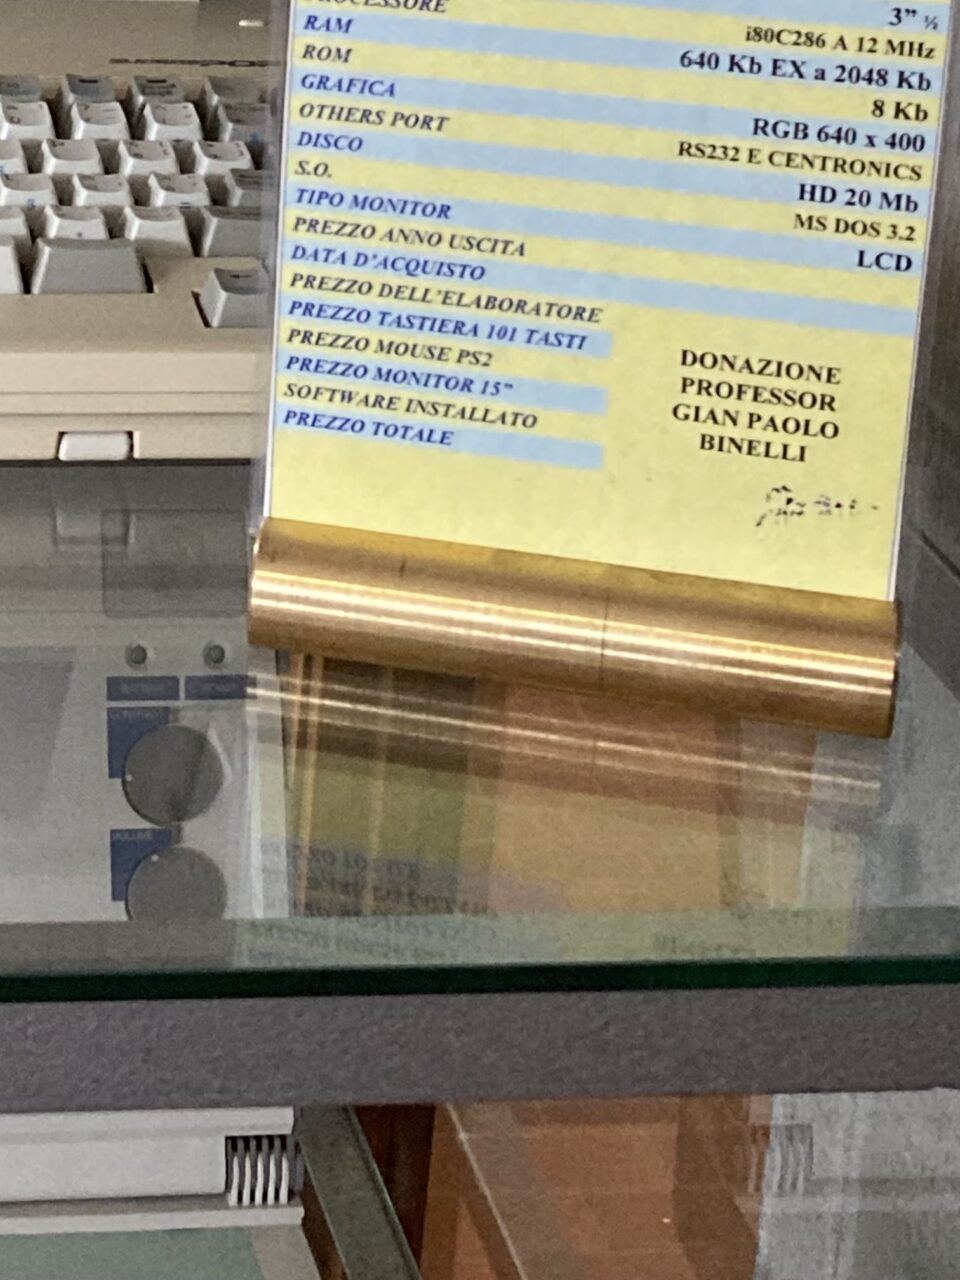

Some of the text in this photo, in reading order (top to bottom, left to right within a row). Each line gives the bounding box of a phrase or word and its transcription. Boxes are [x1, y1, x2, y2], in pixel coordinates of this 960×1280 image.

[303, 14, 355, 34] RAM
[302, 44, 353, 63] ROM
[745, 25, 936, 59] i80C286 A 12 MHz
[301, 73, 397, 98] GRAFICA
[679, 50, 932, 92] 640 Kb EX a 2048 Kb
[299, 102, 450, 132] OTHERS PORT
[871, 99, 928, 122] 8 Kb
[297, 131, 364, 152] DISCO
[752, 118, 926, 153] RGB 640 x 400
[294, 160, 332, 178] S.O.
[678, 141, 922, 182] RS232 E CENTRONICS
[295, 189, 452, 220] TIPO MONITOR
[797, 183, 919, 213] HD 20 Mb
[292, 217, 526, 257] PREZZO ANNO USCITA
[793, 213, 916, 242] MS DOS 3.2
[291, 246, 347, 265] DATA
[856, 250, 913, 272] LCD
[290, 273, 373, 296] PREZZO
[289, 300, 589, 350] PREZZO TASTIERA 101 TASTI
[286, 329, 494, 367] PREZZO MOUSE PS2
[285, 356, 368, 379] PREZZO
[372, 367, 476, 393] MONITOR
[680, 349, 842, 385] DONAZIONE
[284, 383, 538, 429] SOFTWARE INSTALLATO
[680, 377, 836, 412] PROFESSOR
[283, 410, 455, 446] PREZZO TOTALE
[672, 404, 839, 440] GIAN PAOLO
[699, 433, 808, 463] BINELLI
